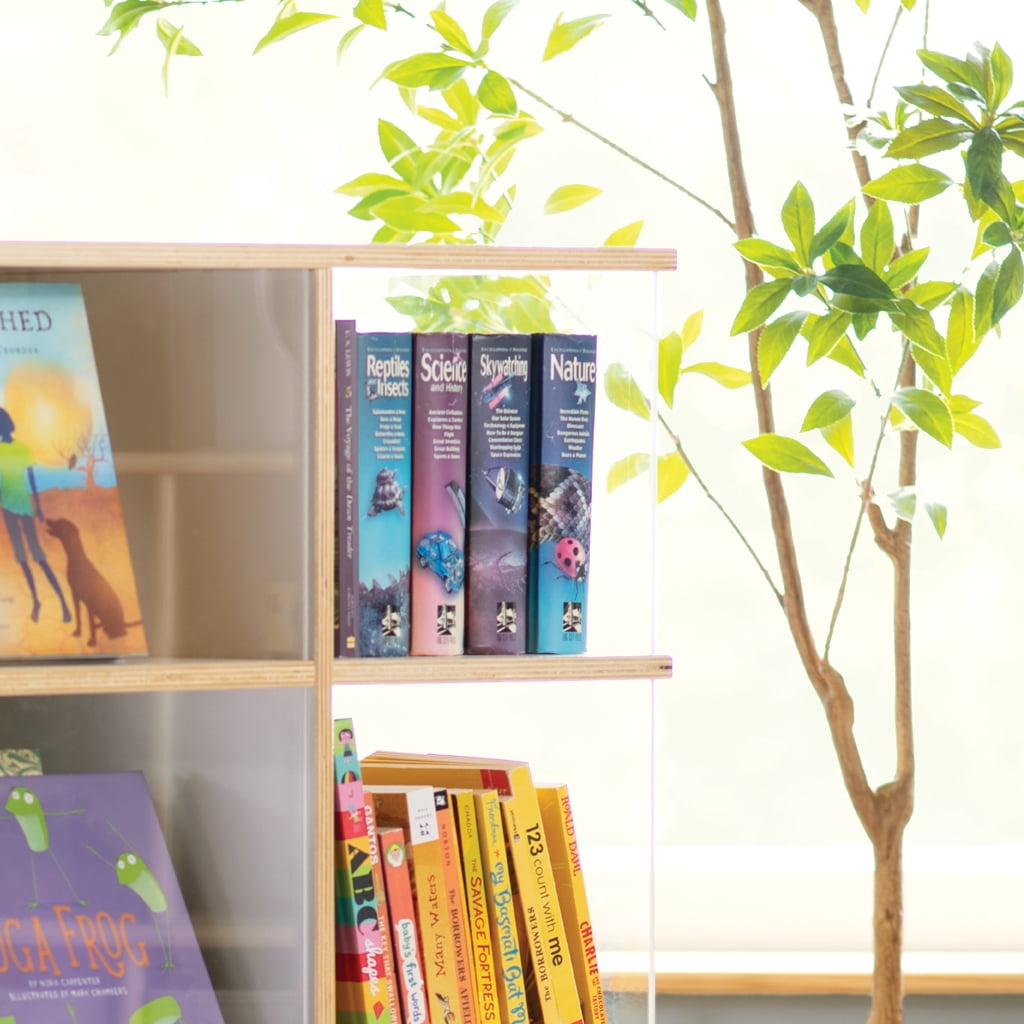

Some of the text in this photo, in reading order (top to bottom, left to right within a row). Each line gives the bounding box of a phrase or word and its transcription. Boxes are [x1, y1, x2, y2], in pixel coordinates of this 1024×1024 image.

[367, 354, 410, 381] Reptiles
[421, 353, 468, 383] Science
[480, 354, 528, 382] Skywatching
[550, 354, 596, 383] Nature
[377, 379, 410, 397] Insects
[430, 384, 445, 392] and
[343, 427, 352, 460] Voyage
[440, 824, 451, 867] NORTON
[470, 858, 479, 873] THE
[489, 862, 507, 885] my
[348, 843, 379, 936] ABC
[447, 889, 457, 905] The
[526, 823, 563, 967] 123 count with me
[561, 796, 598, 975] ROALD DAHL CHARLIE
[377, 915, 387, 931] THE
[470, 876, 486, 940] SAVAGE
[428, 874, 446, 977] Many Waters
[493, 890, 517, 962] Basmati
[53, 905, 151, 979] FROG
[379, 933, 389, 952] KEY
[450, 909, 466, 982] BORROWERS
[528, 907, 548, 982] BORROWERS
[360, 938, 382, 995] shapes
[381, 954, 393, 977] THAT
[399, 922, 420, 1022] baby's first words
[9, 991, 60, 1001] ILLUSTRATED
[61, 976, 101, 987] CARPENTER
[477, 944, 495, 1020] FORTRESS
[503, 966, 523, 1000] Bat
[541, 985, 552, 1003] The
[590, 995, 601, 1020] FACTORY
